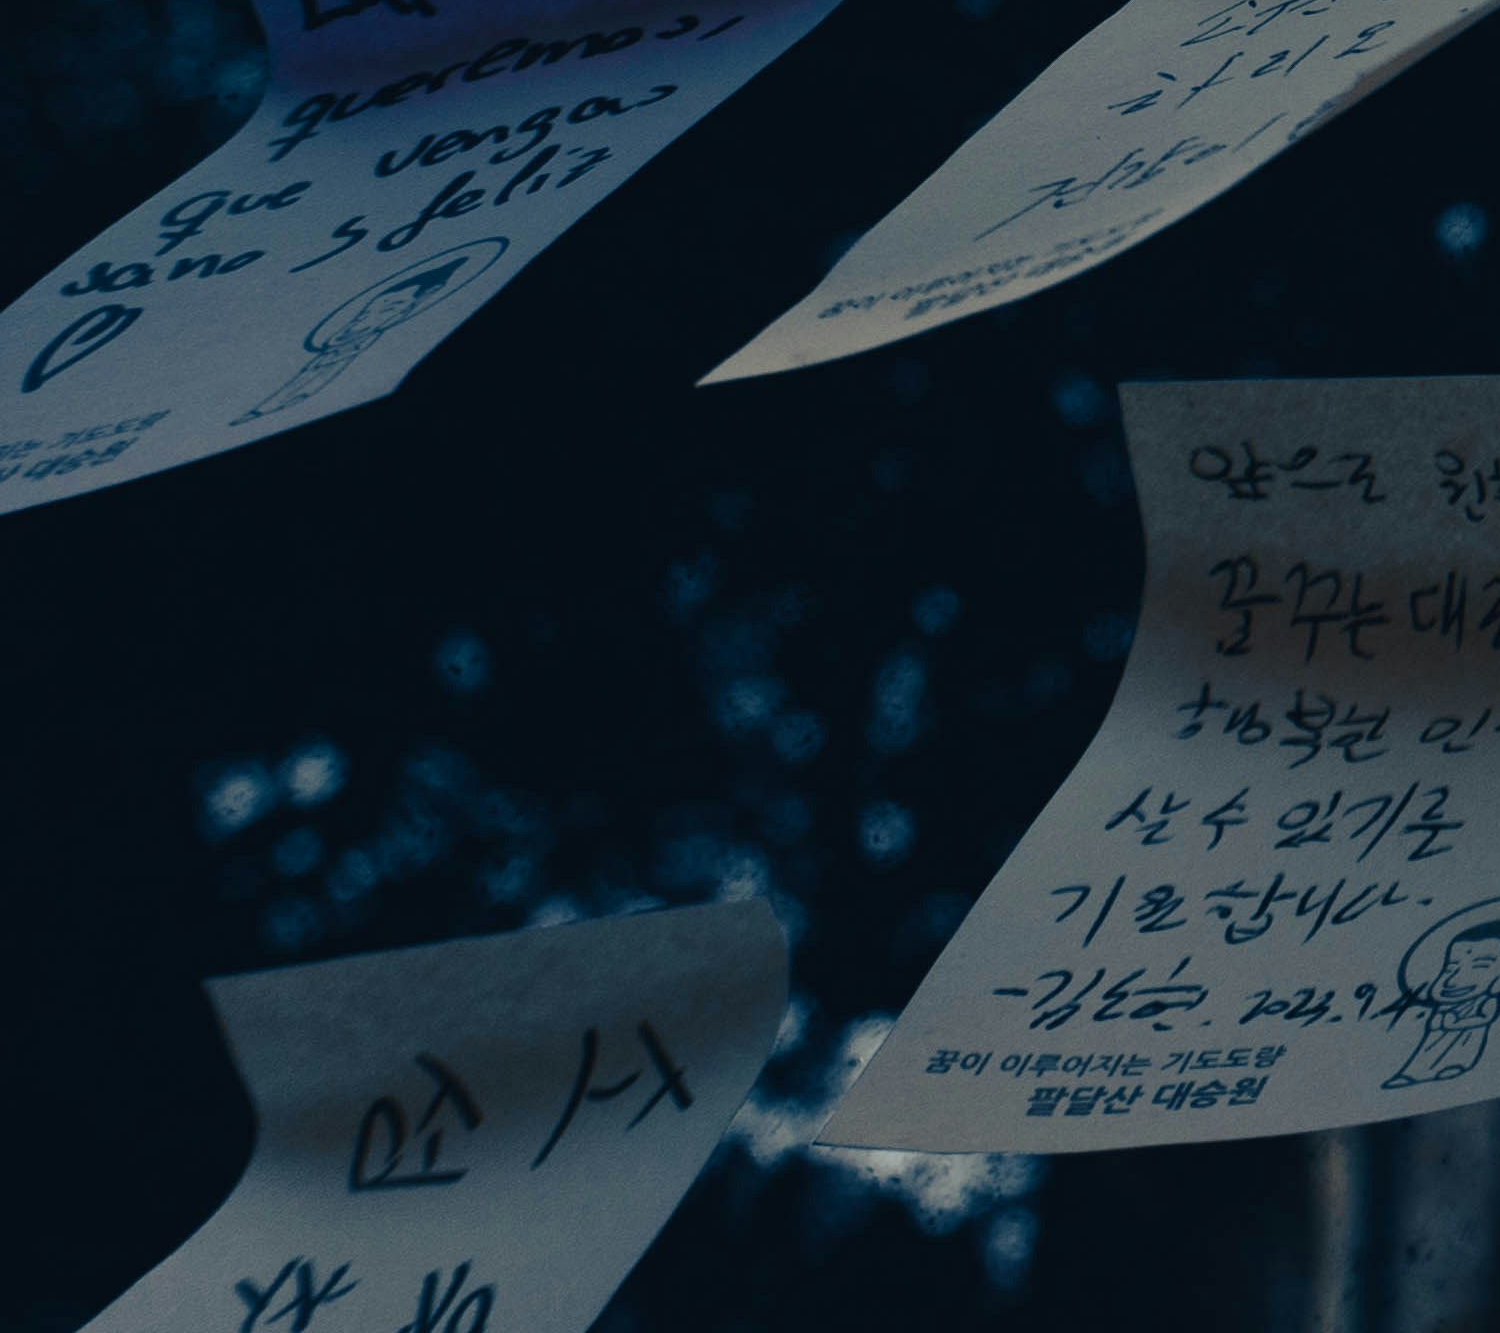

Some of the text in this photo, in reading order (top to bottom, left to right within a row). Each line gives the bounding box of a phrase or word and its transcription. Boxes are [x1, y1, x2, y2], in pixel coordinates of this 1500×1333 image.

[152, 179, 315, 257] que
[1187, 439, 1389, 505] 앞으로
[1199, 785, 1254, 851] 수
[923, 1044, 1289, 1081] 꿈이 이루어지는 기도도량
[1025, 1075, 1271, 1120] 팔달산 대승원
